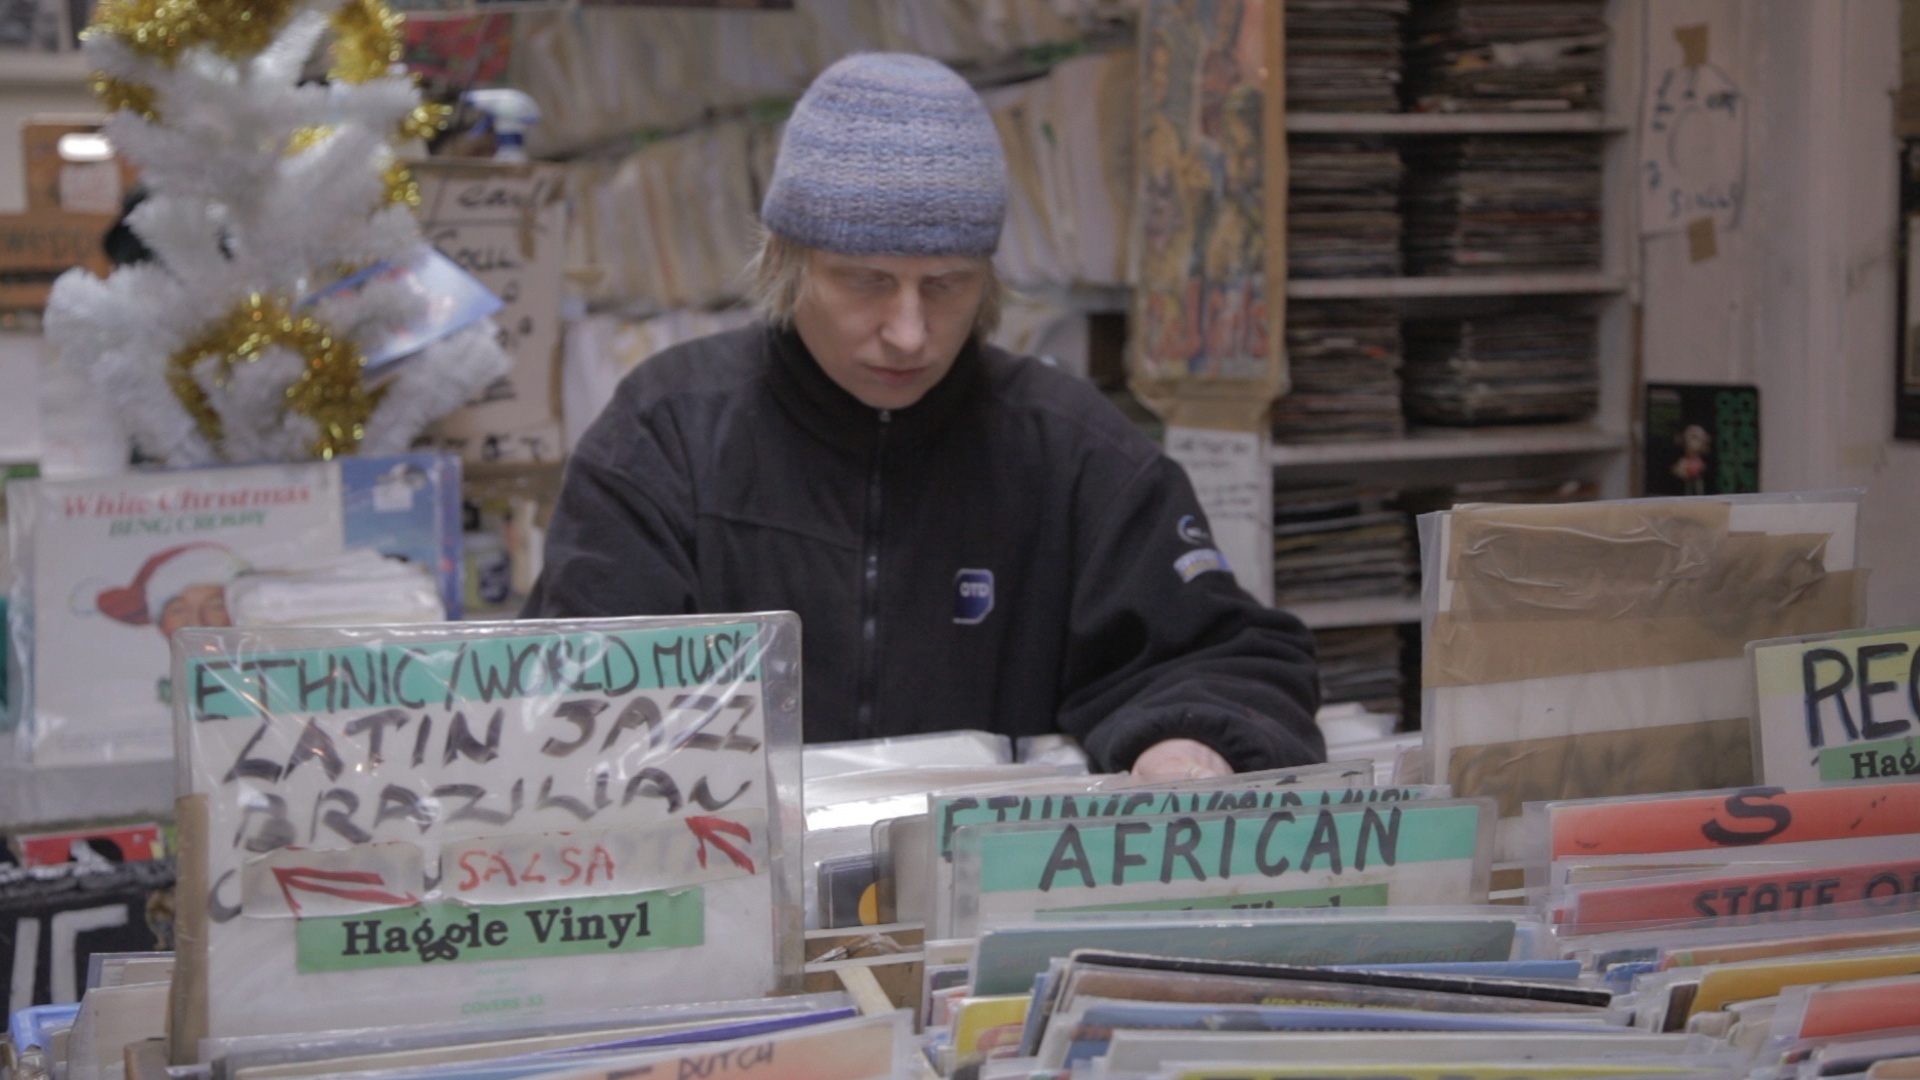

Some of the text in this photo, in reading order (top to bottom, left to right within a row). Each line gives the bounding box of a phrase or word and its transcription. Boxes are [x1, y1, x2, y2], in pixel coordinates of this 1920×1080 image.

[654, 631, 756, 690] MUSIC
[1803, 642, 1920, 748] RE
[224, 695, 761, 784] LATIN JAZZ
[232, 767, 752, 853] BRAZILIAN
[1702, 786, 1791, 846] S
[459, 844, 615, 892] SALSA
[1039, 805, 1401, 893] AFRICAN
[342, 901, 651, 963] Haggle Vinyl
[677, 1041, 775, 1080] DUTCH
